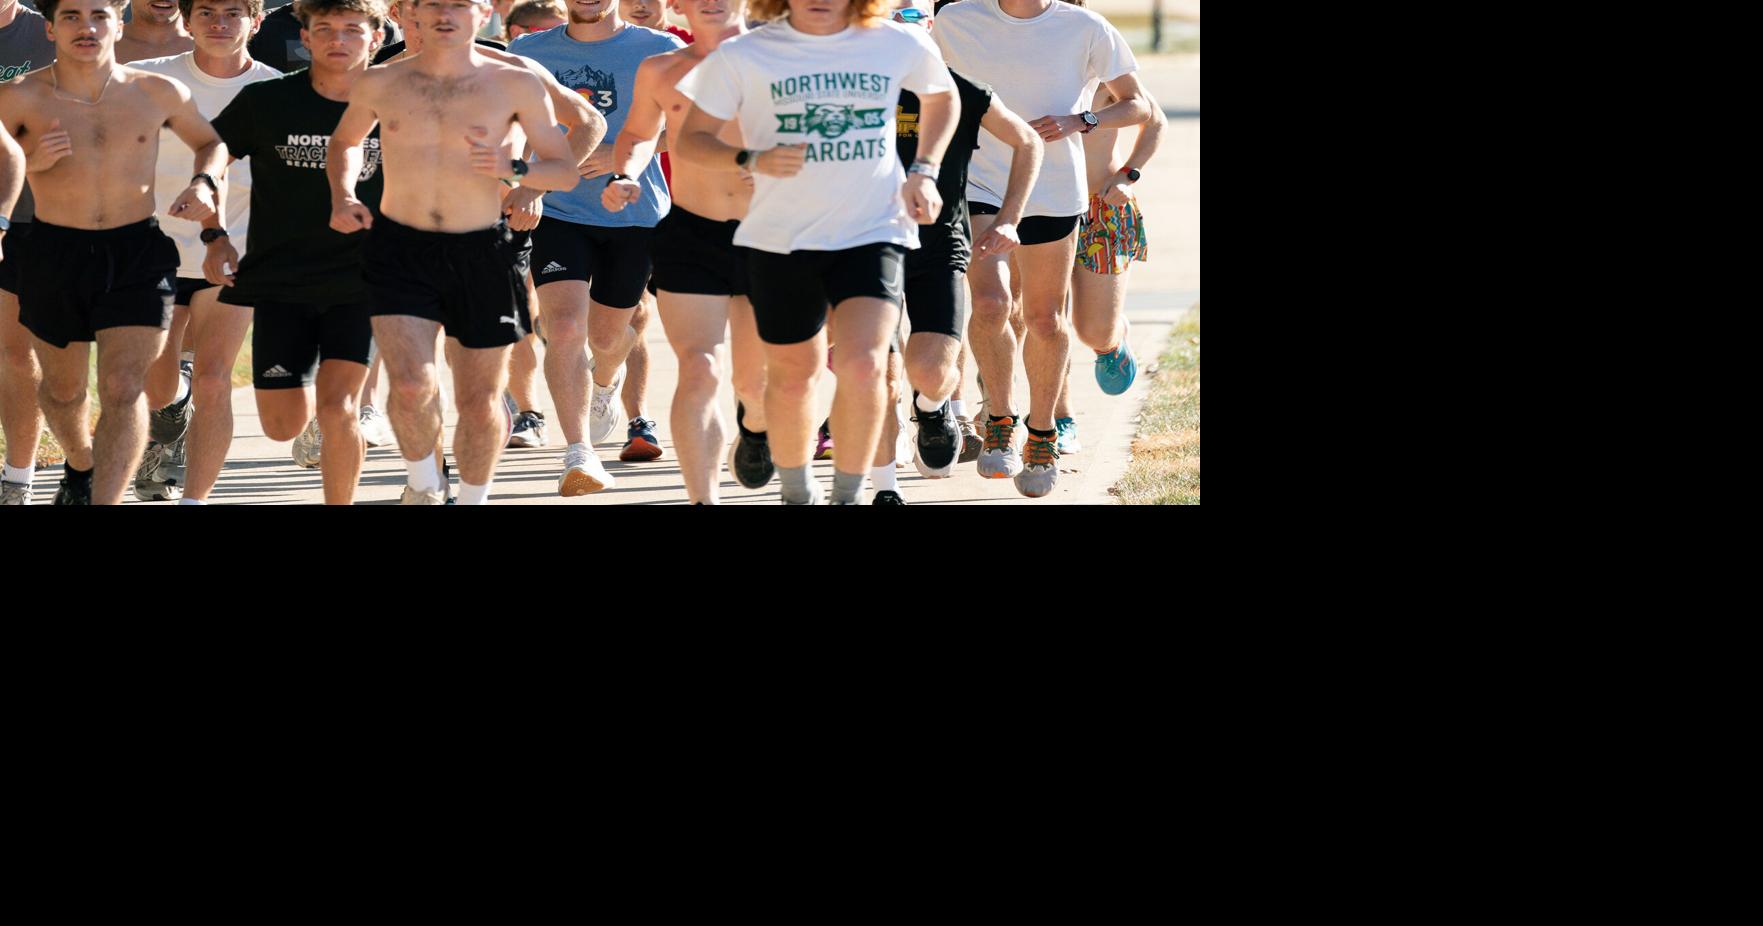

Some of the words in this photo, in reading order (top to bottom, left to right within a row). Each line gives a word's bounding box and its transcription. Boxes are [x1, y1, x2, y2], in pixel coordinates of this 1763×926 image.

[771, 72, 891, 99] NORTHWEST
[864, 111, 880, 125] 05
[777, 137, 886, 162] ARCATS
